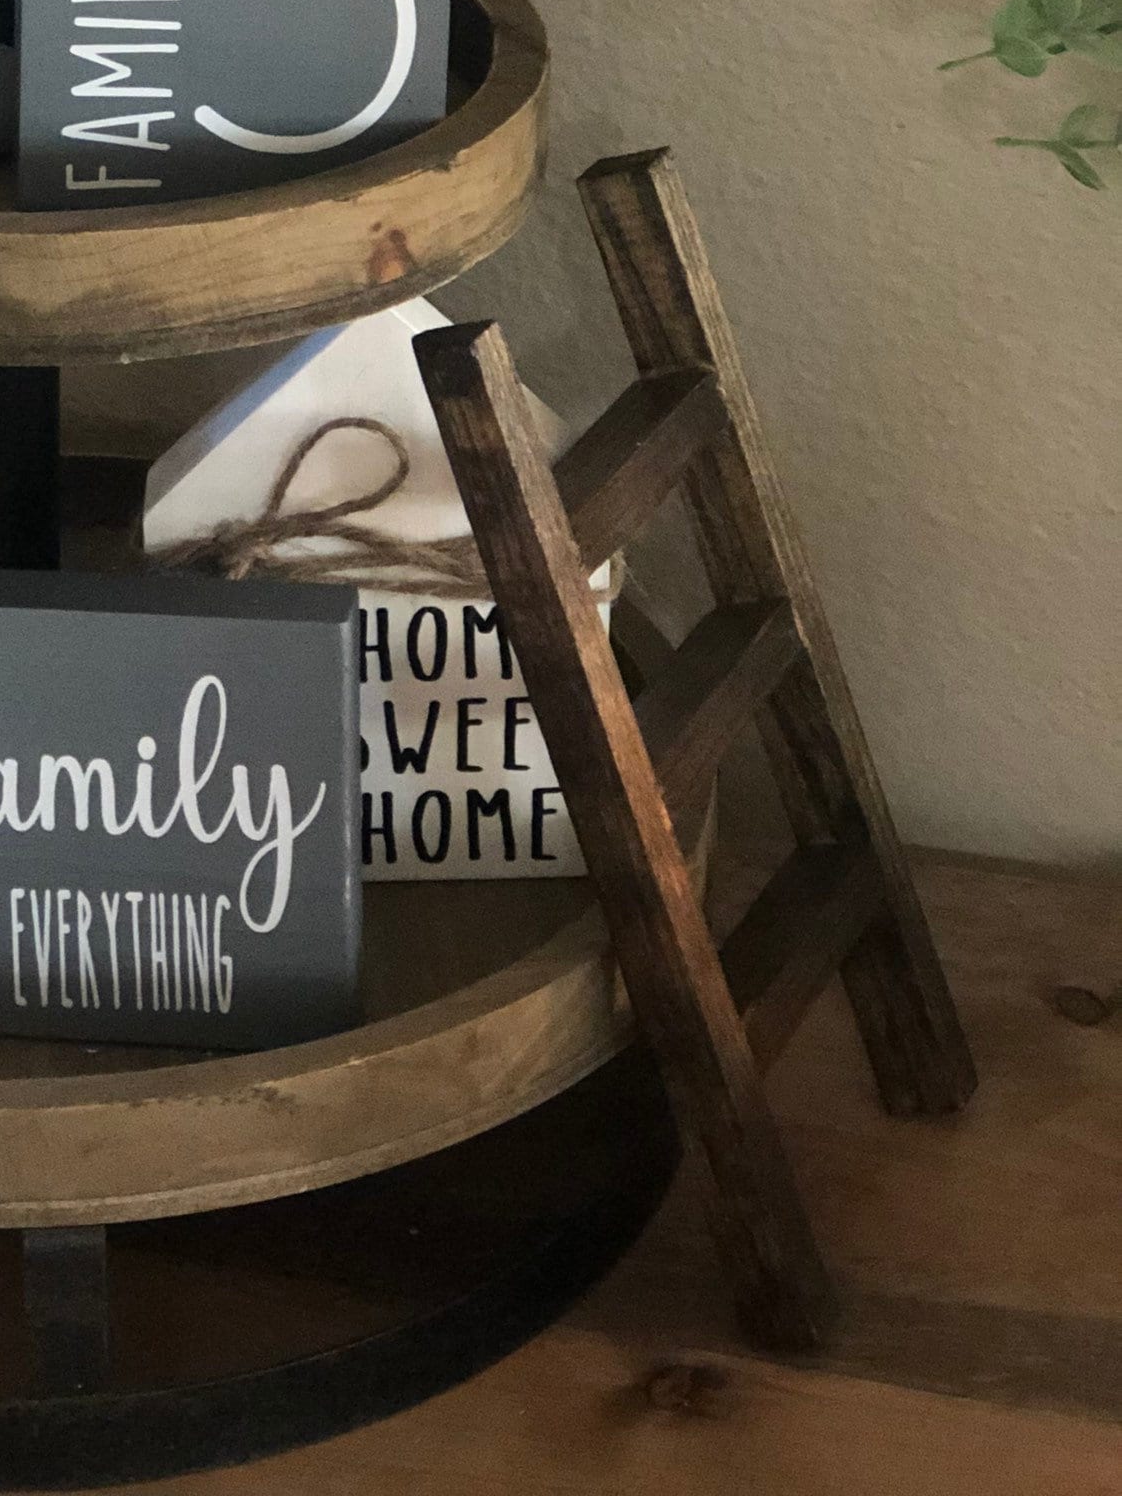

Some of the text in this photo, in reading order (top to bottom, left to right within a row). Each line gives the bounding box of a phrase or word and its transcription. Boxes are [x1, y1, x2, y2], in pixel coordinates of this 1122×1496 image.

[359, 605, 513, 683] HOM
[359, 696, 531, 774] WEE
[361, 788, 563, 865] HOME
[10, 888, 233, 1014] EVERYTHING
